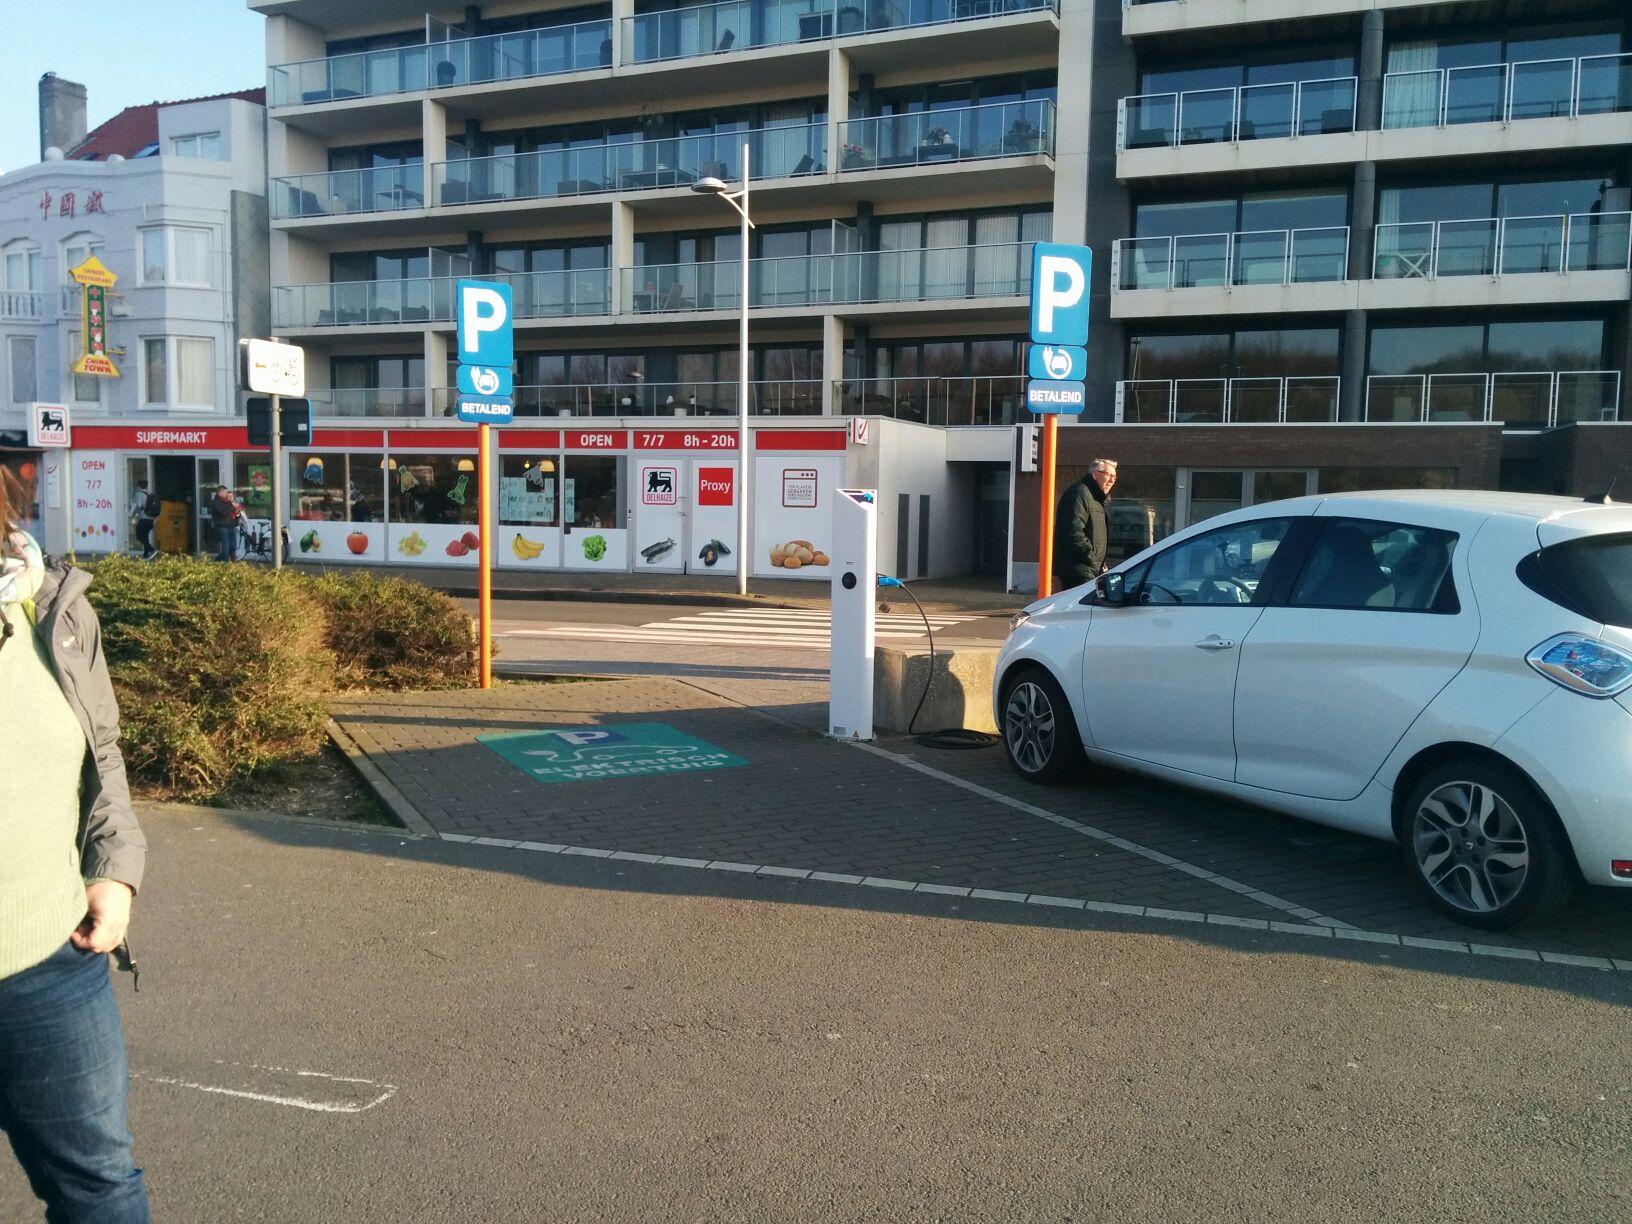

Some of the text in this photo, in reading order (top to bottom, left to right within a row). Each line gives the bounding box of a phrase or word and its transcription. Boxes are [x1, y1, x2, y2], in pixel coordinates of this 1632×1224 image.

[1038, 256, 1085, 333] P
[463, 287, 507, 353] P
[85, 357, 110, 366] CHINA
[84, 364, 112, 374] TOWN
[1029, 389, 1082, 403] BETALEND
[461, 402, 511, 415] BETALEND
[136, 431, 207, 443] SUPERMARKT
[580, 434, 613, 447] OPEN
[642, 434, 665, 447] 7/7
[684, 435, 699, 447] 8h
[711, 435, 735, 447] 20h
[82, 461, 106, 470] OPEN
[86, 480, 102, 489] 7/7
[701, 479, 731, 494] Proxy
[77, 499, 88, 509] 8h
[95, 499, 112, 509] 20h
[646, 493, 673, 502] DELHAIZE
[555, 731, 609, 745] P
[533, 753, 729, 774] ELEKTRISCH
[562, 760, 723, 778] VOERTUIG
